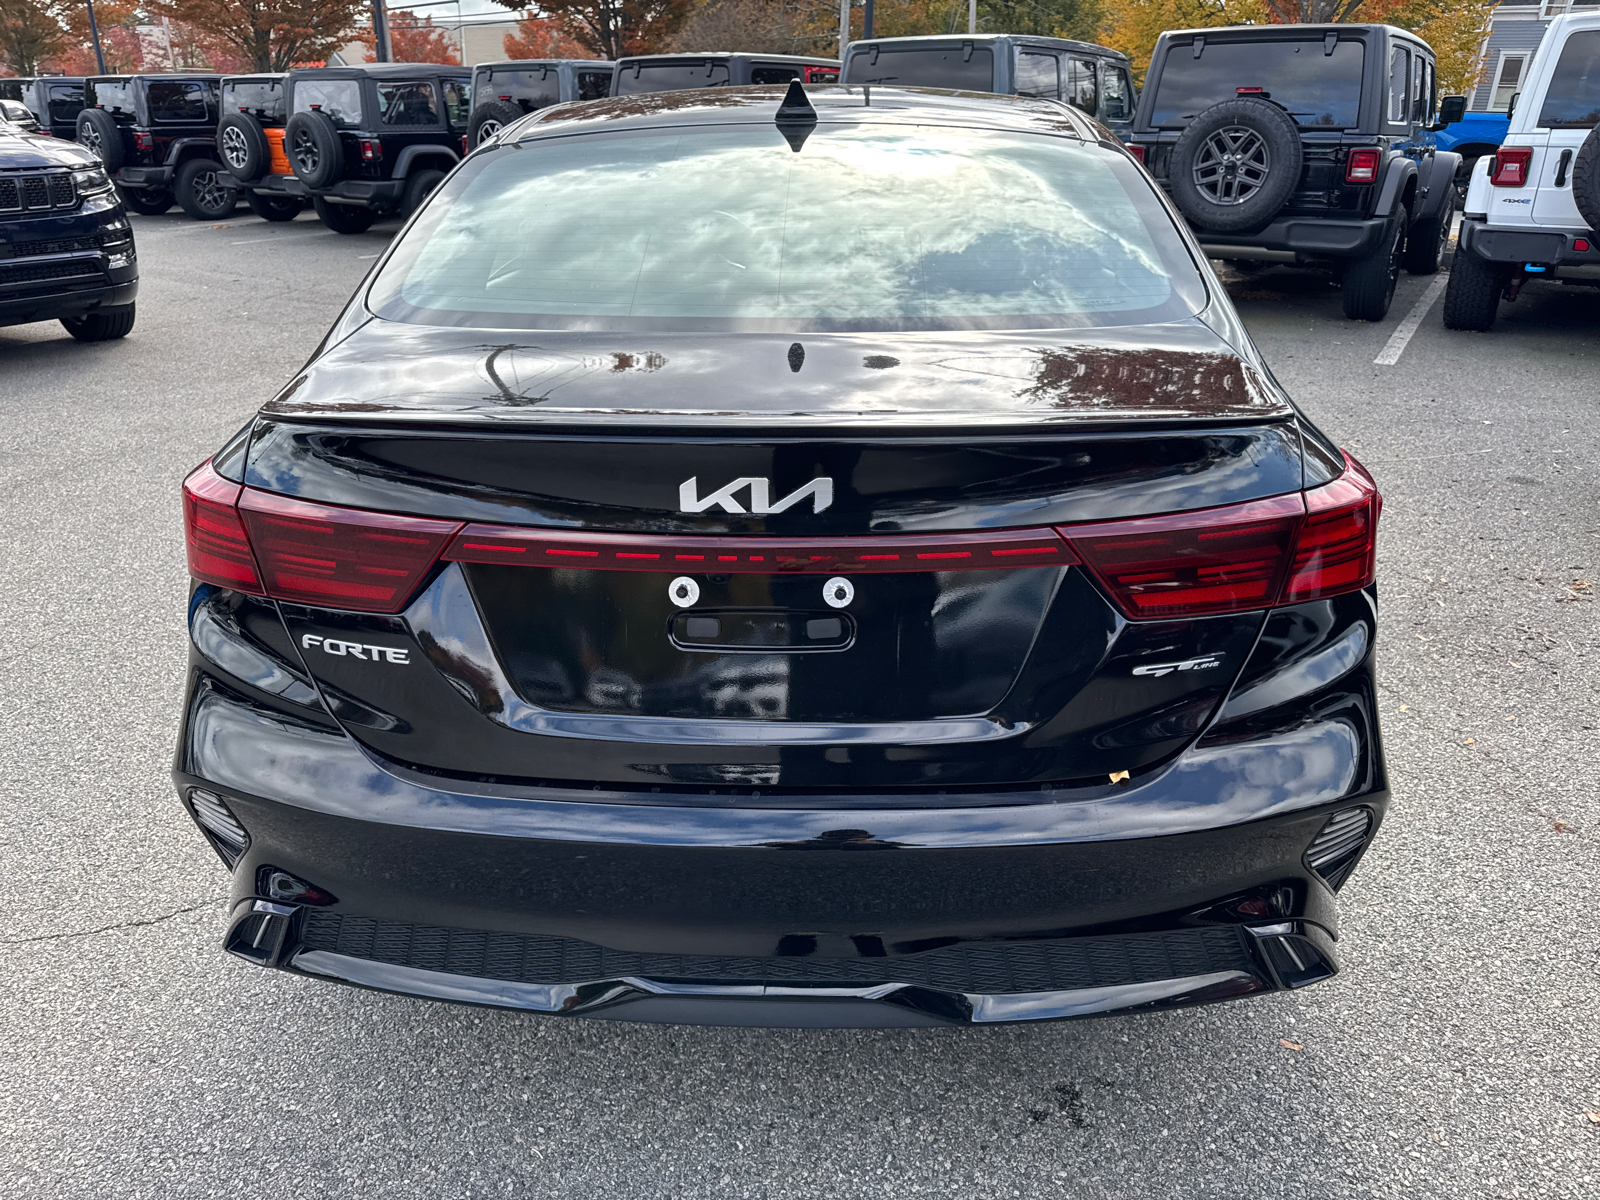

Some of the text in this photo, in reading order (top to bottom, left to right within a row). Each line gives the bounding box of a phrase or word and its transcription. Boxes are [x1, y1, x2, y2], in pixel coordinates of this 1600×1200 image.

[679, 476, 833, 514] KIA
[302, 634, 410, 664] FORTE
[1132, 657, 1215, 677] GT
